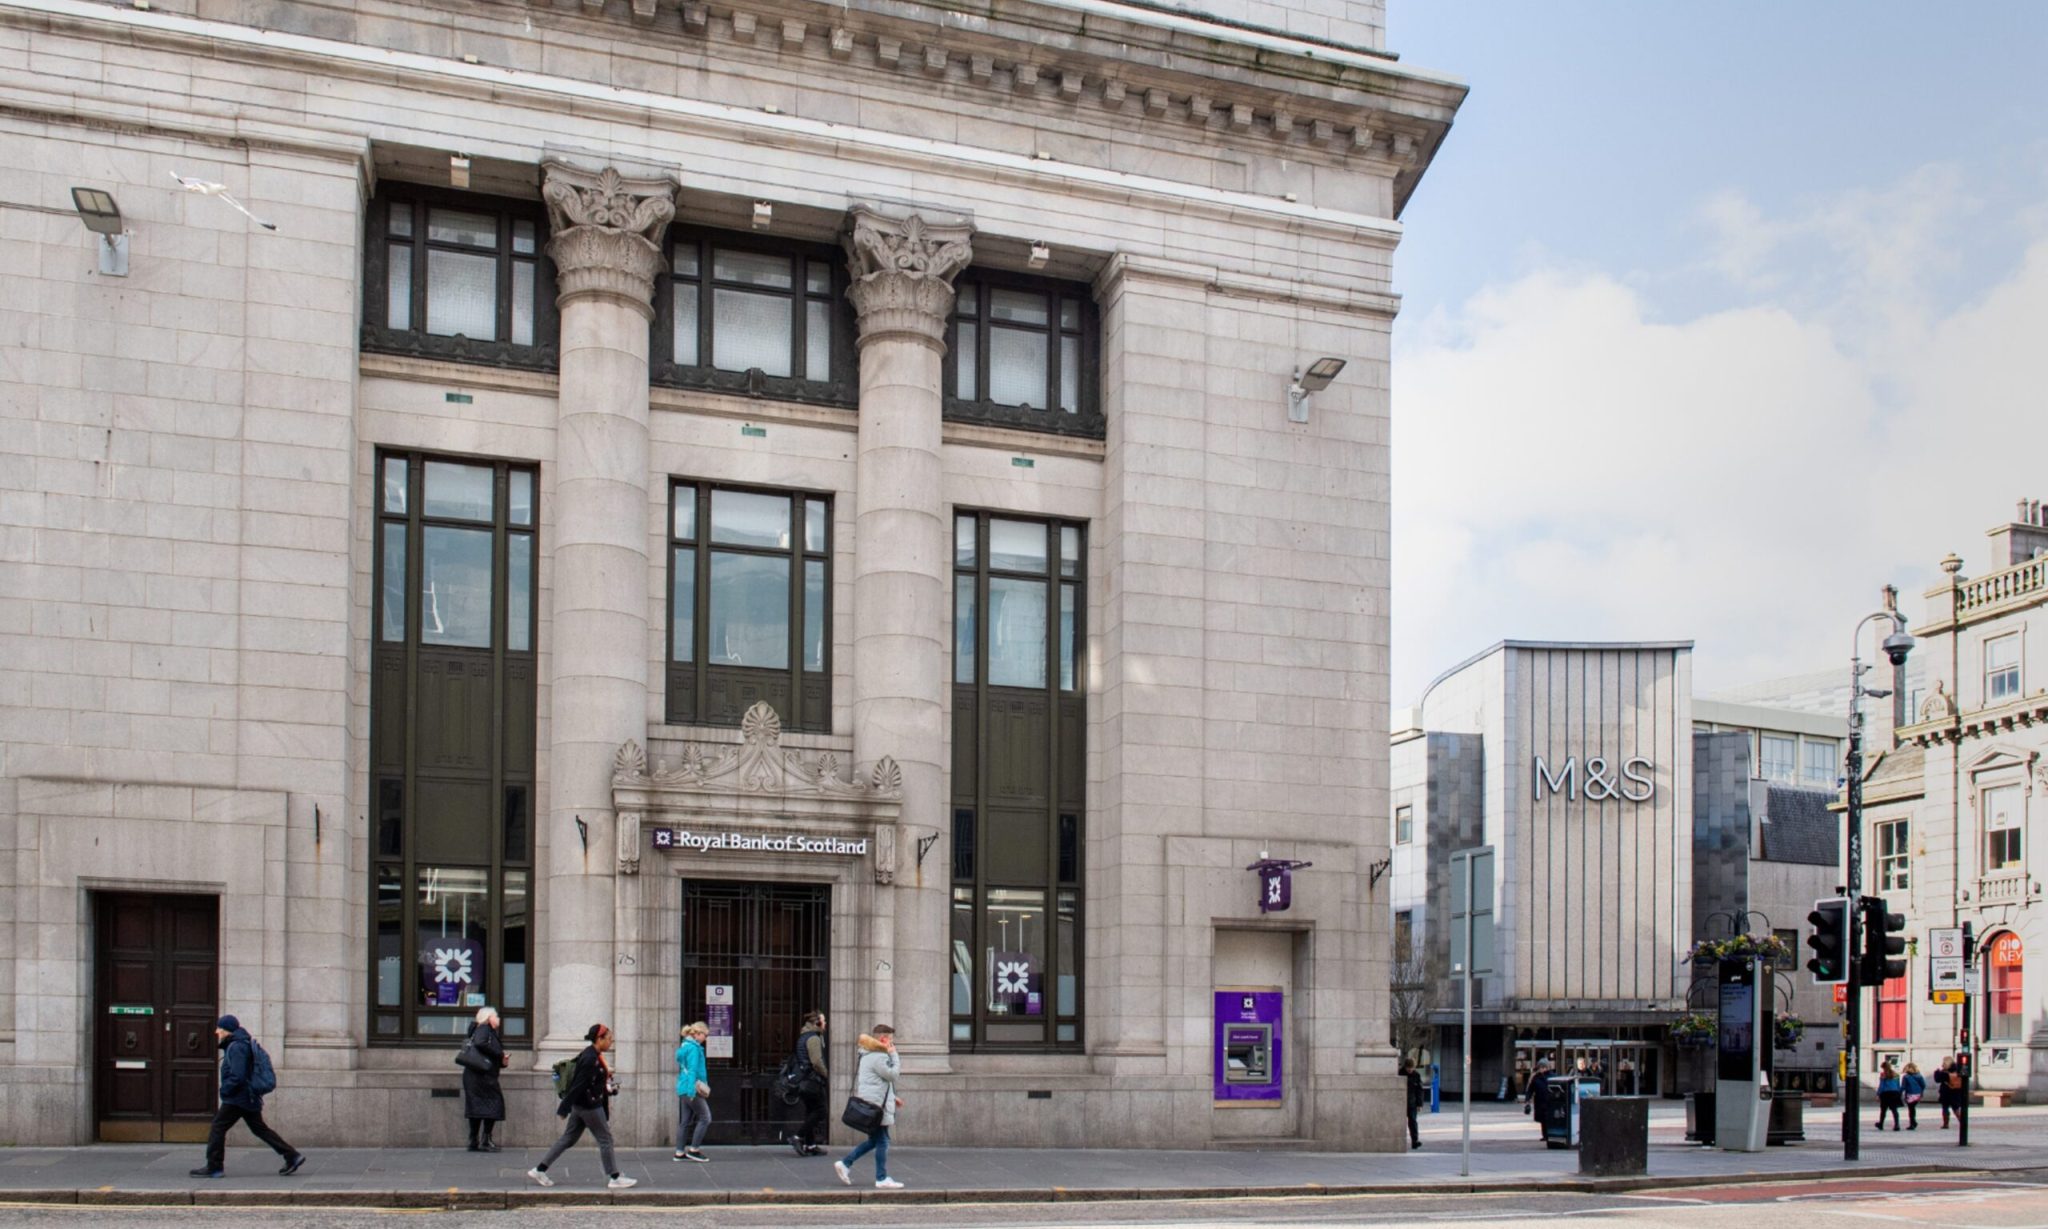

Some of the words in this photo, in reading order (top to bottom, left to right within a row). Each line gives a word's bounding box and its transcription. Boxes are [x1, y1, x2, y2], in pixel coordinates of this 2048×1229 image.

[1534, 756, 1656, 802] M&S
[680, 831, 726, 853] Royal
[730, 833, 770, 850] Bank
[773, 835, 793, 851] of
[797, 836, 867, 855] Scotland
